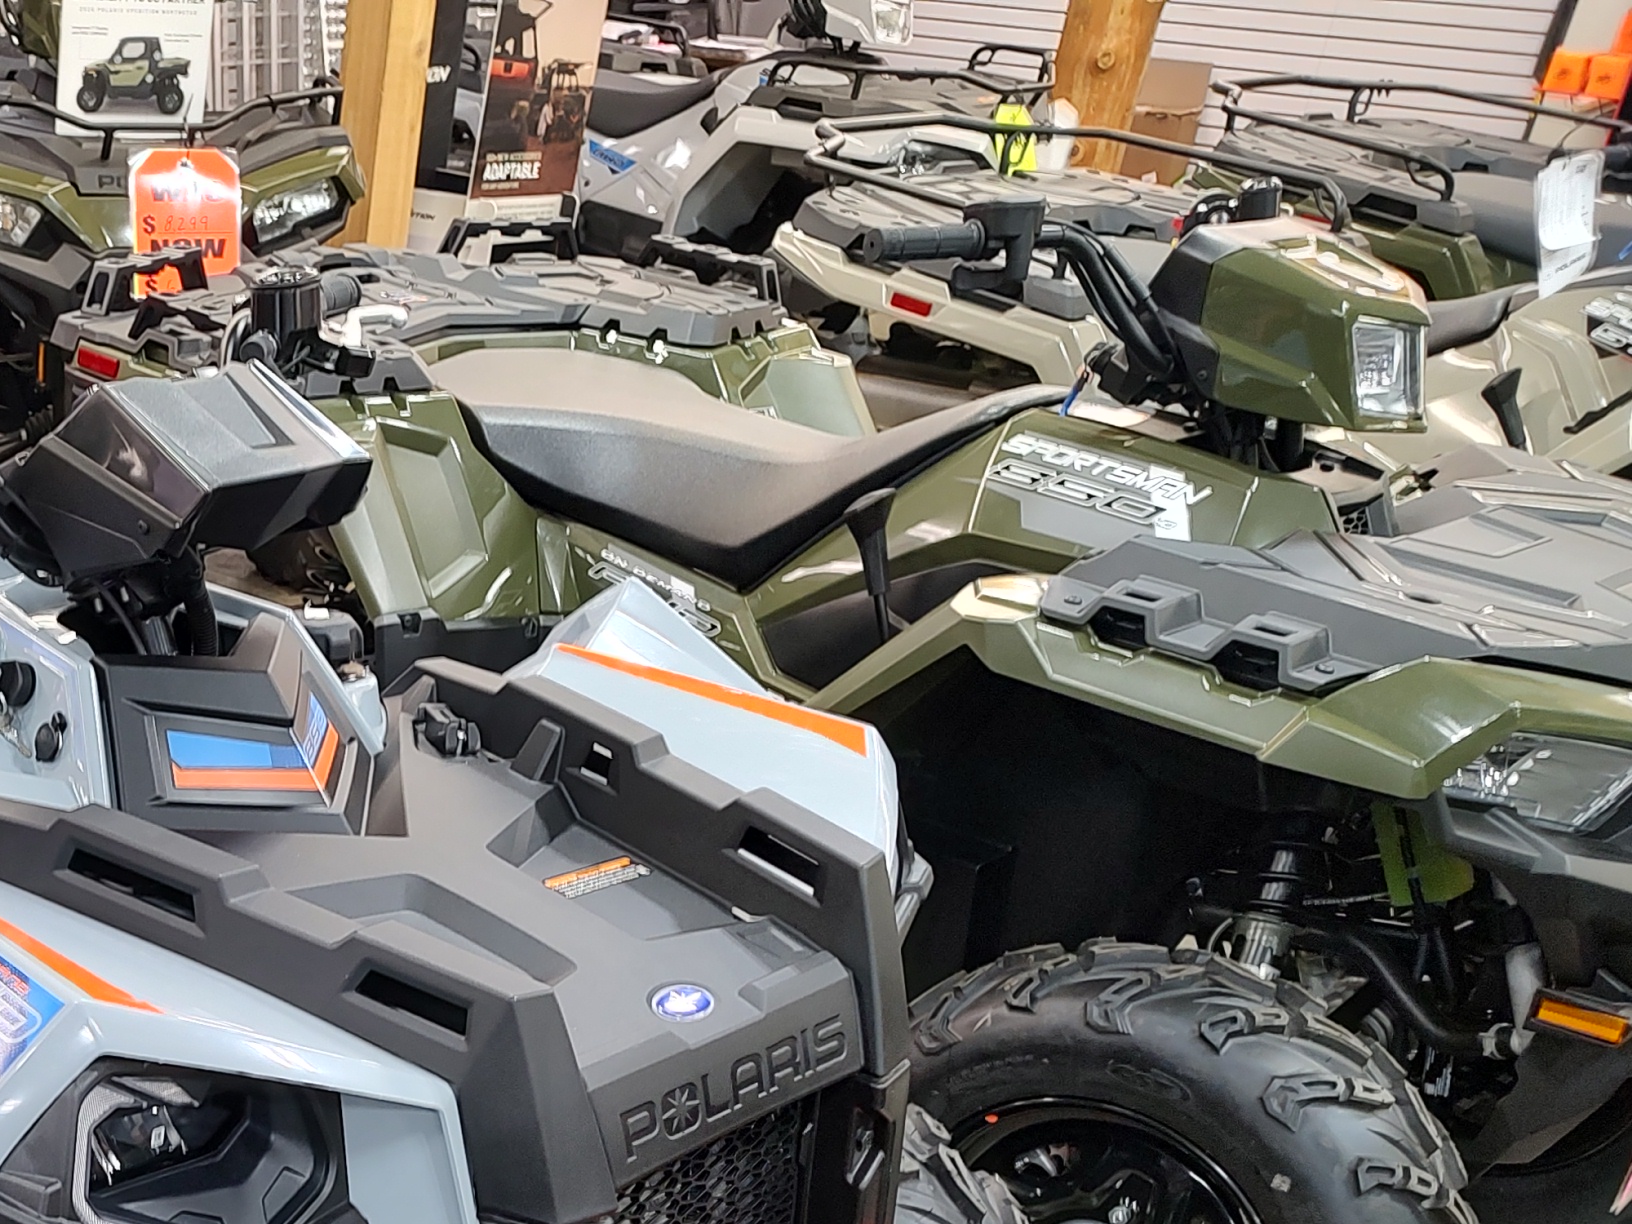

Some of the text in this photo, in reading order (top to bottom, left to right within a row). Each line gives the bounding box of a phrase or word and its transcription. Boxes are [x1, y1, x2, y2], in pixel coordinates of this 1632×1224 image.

[482, 161, 541, 181] ADAPTABLE
[1001, 433, 1213, 505] SPORTSMAN
[619, 1013, 848, 1163] POLARIS
